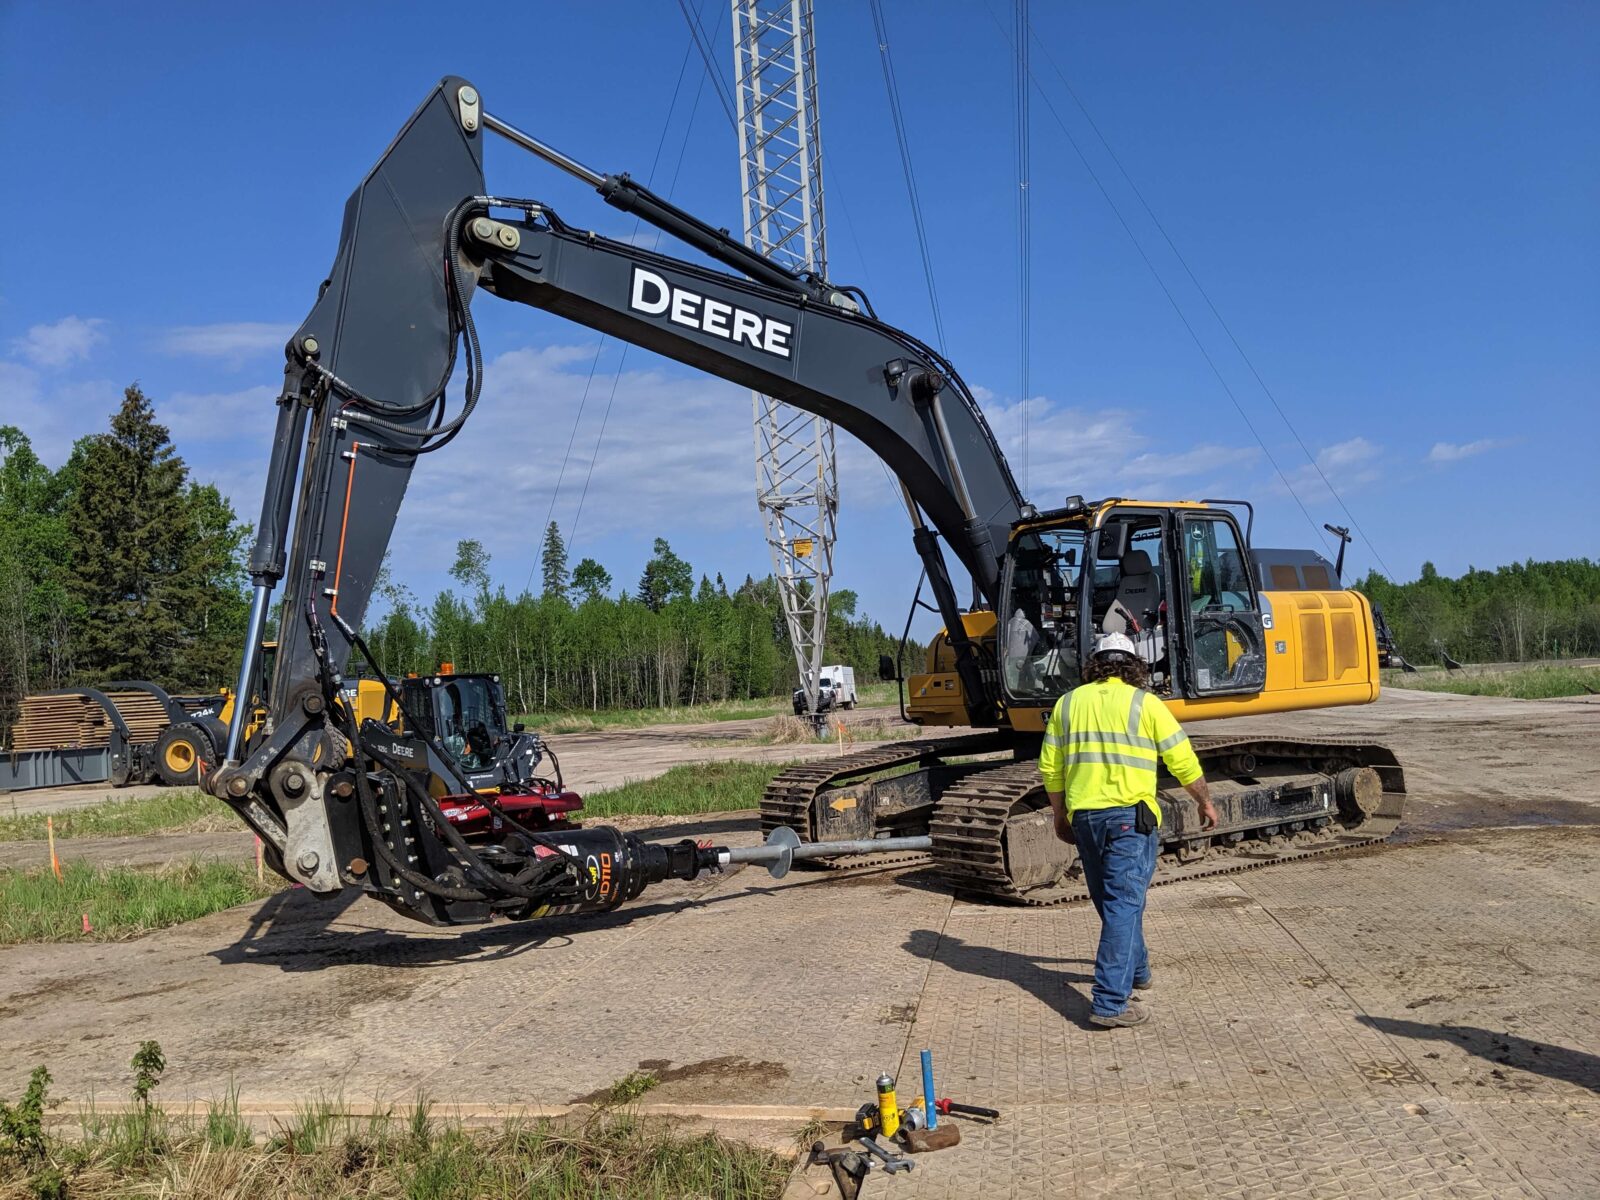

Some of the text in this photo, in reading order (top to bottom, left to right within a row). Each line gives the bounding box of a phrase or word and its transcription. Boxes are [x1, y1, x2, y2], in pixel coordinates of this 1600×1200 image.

[631, 267, 792, 357] DEERE
[190, 708, 214, 717] 724K
[392, 742, 414, 758] DEERE
[597, 852, 611, 904] MD110
